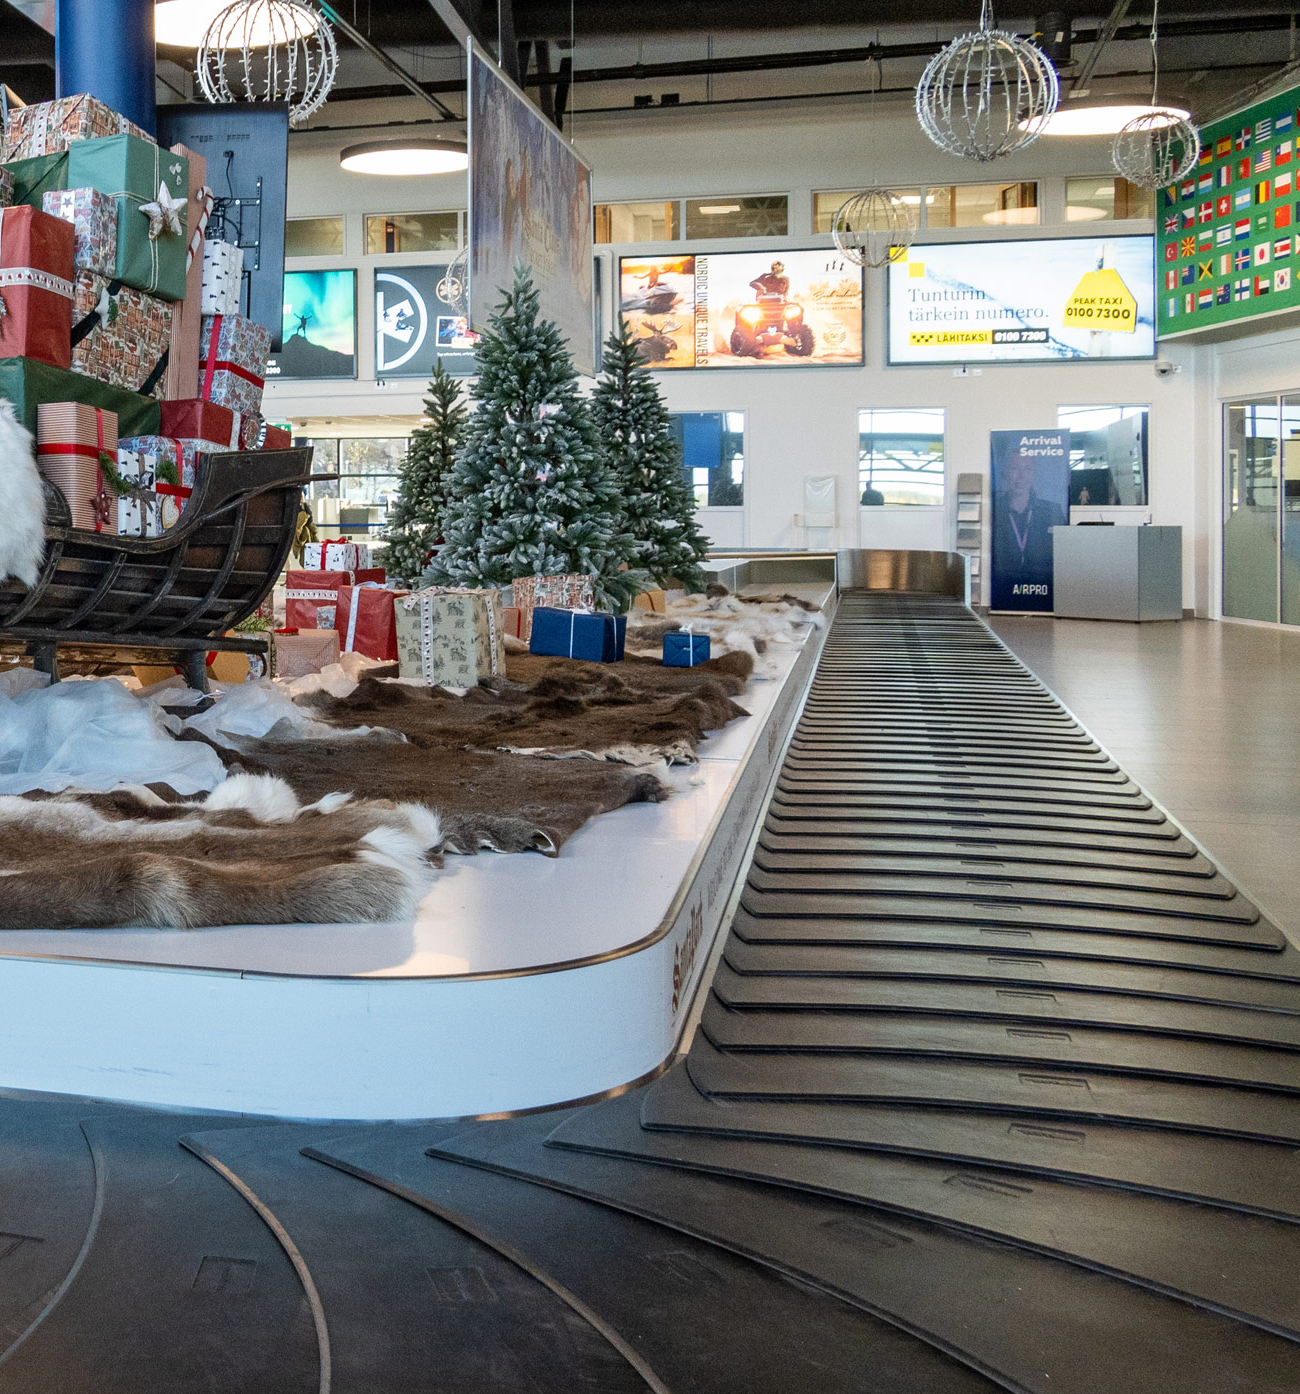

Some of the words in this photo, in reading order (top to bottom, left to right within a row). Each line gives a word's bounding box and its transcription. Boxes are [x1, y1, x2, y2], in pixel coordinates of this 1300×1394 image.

[696, 258, 708, 290] NORDIC
[908, 286, 986, 302] Tunturin
[1073, 297, 1096, 305] PEAK
[1099, 297, 1123, 305] TAXI
[696, 292, 708, 325] UNIQUE
[909, 306, 969, 322] tärkein
[976, 307, 1049, 320] numero.
[1066, 307, 1094, 318] 0100
[1096, 308, 1131, 319] 7300
[937, 331, 988, 343] LÄHITAKSI
[994, 331, 1019, 342] 0100
[1021, 330, 1047, 341] 7300
[696, 327, 709, 365] TRAVELS
[1020, 435, 1062, 446] Arrival
[1020, 446, 1064, 457] Service
